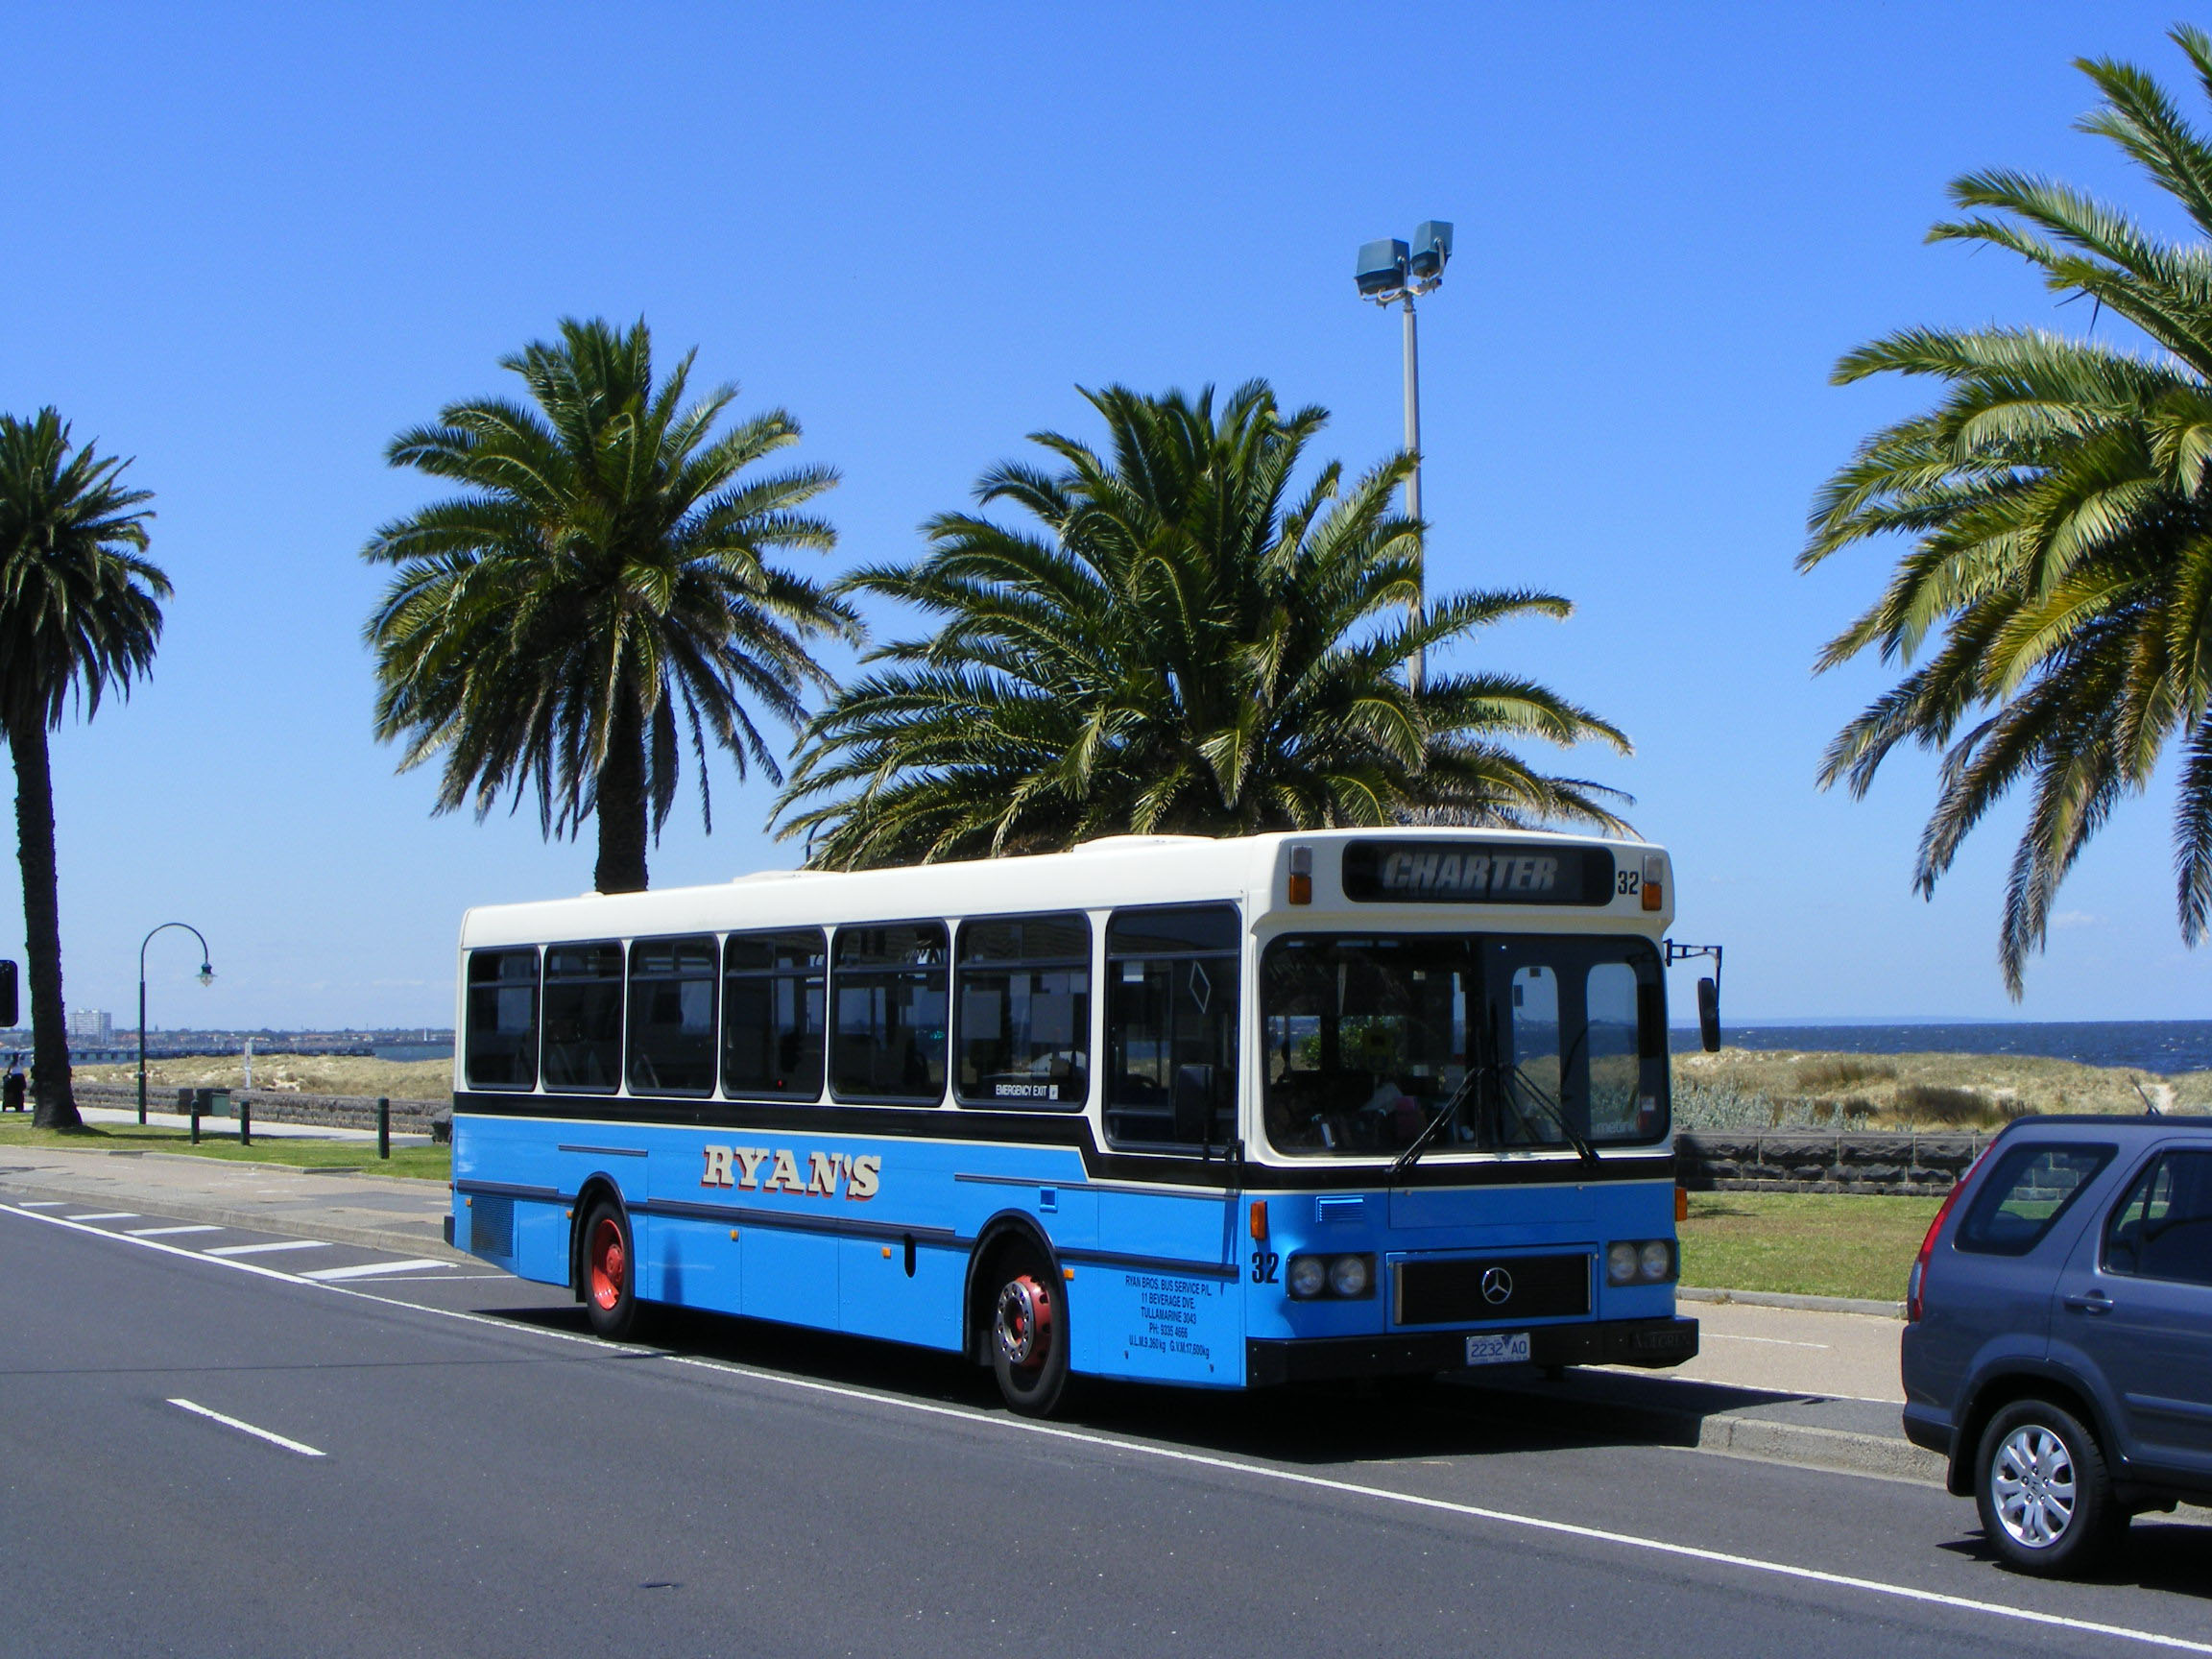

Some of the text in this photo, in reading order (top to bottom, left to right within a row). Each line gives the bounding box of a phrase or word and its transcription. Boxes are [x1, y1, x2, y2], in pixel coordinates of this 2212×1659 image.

[1382, 852, 1559, 891] CHARTER
[1618, 871, 1639, 895] 32
[996, 1084, 1047, 1096] EMERGENCY EXIT
[701, 1144, 881, 1202] RYAN'S
[1252, 1252, 1279, 1284] 32
[1125, 1275, 1141, 1287] RYAN
[1142, 1277, 1160, 1290] BROS.
[1161, 1279, 1174, 1292] BUS
[1174, 1281, 1200, 1295] SERVICE
[1141, 1292, 1147, 1304] 11
[1148, 1293, 1181, 1308] BEVERAGE
[1141, 1307, 1196, 1324] TULLAMARINE 3043
[1471, 1342, 1503, 1358] 2232
